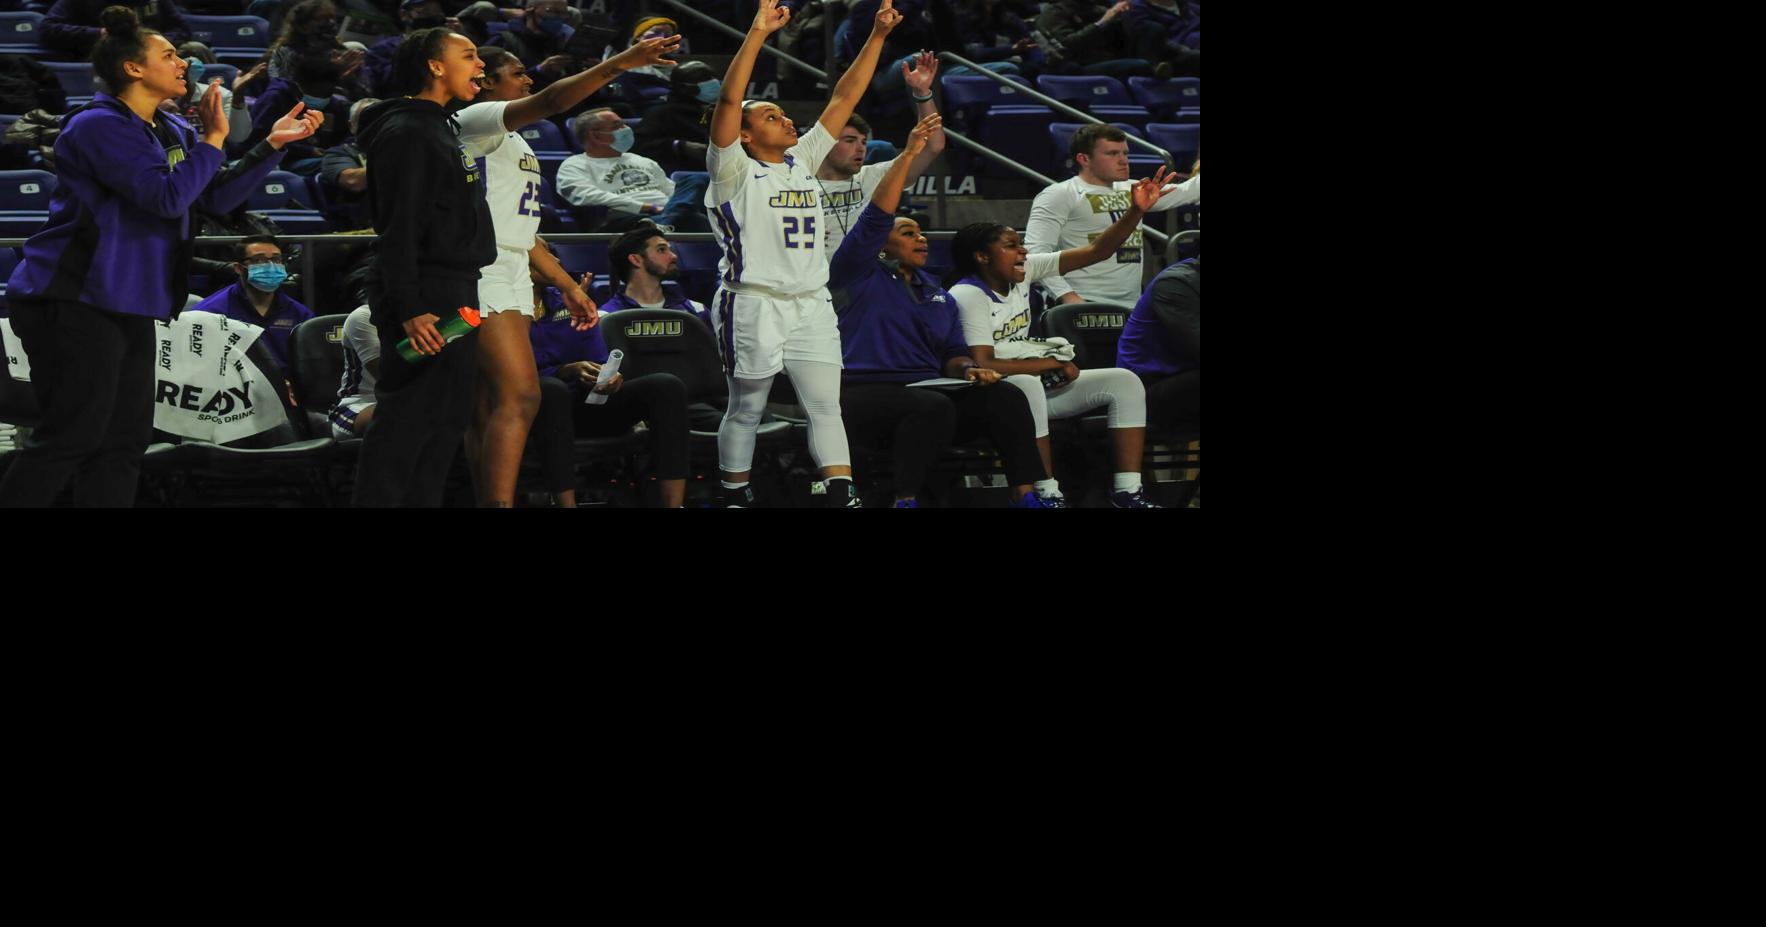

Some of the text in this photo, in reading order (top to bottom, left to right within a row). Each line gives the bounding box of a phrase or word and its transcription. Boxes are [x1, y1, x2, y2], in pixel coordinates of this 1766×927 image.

[745, 81, 778, 99] LA
[910, 175, 976, 195] ILLA
[769, 189, 817, 208] JMU
[820, 188, 864, 209] MU
[782, 216, 816, 249] 25
[625, 320, 684, 337] JMU
[1073, 313, 1125, 328] JMU
[192, 323, 203, 358] READY
[161, 339, 172, 371] READY
[155, 379, 253, 416] READY
[224, 409, 256, 423] DRINK
